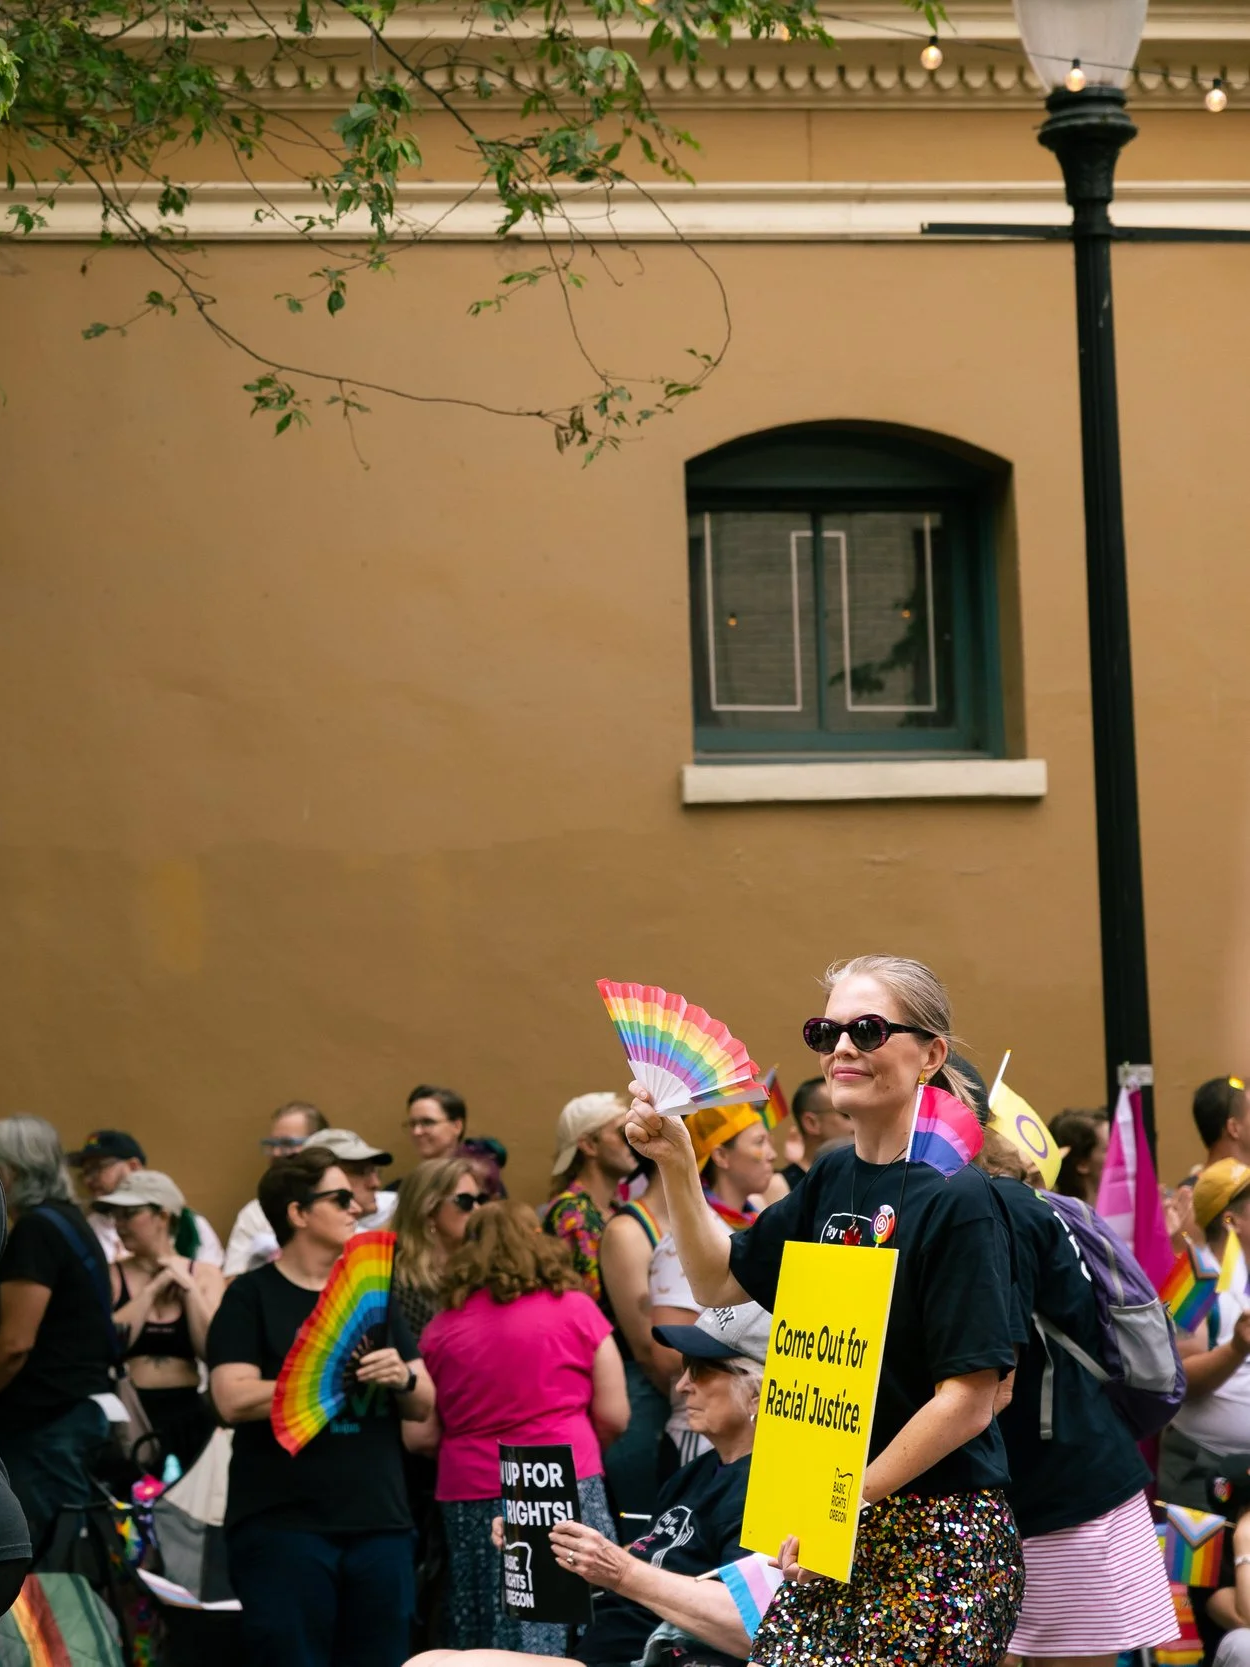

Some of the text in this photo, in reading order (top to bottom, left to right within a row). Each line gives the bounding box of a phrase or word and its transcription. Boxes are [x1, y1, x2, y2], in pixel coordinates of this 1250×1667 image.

[775, 1319, 868, 1368] Come Out for
[765, 1379, 860, 1434] Racial Justice.
[504, 1461, 520, 1486] UP
[522, 1462, 564, 1488] FOR
[833, 1481, 846, 1494] BASIC
[506, 1500, 574, 1526] RIGHTS!
[831, 1495, 846, 1509] RIGHTS
[829, 1509, 847, 1523] OREGON
